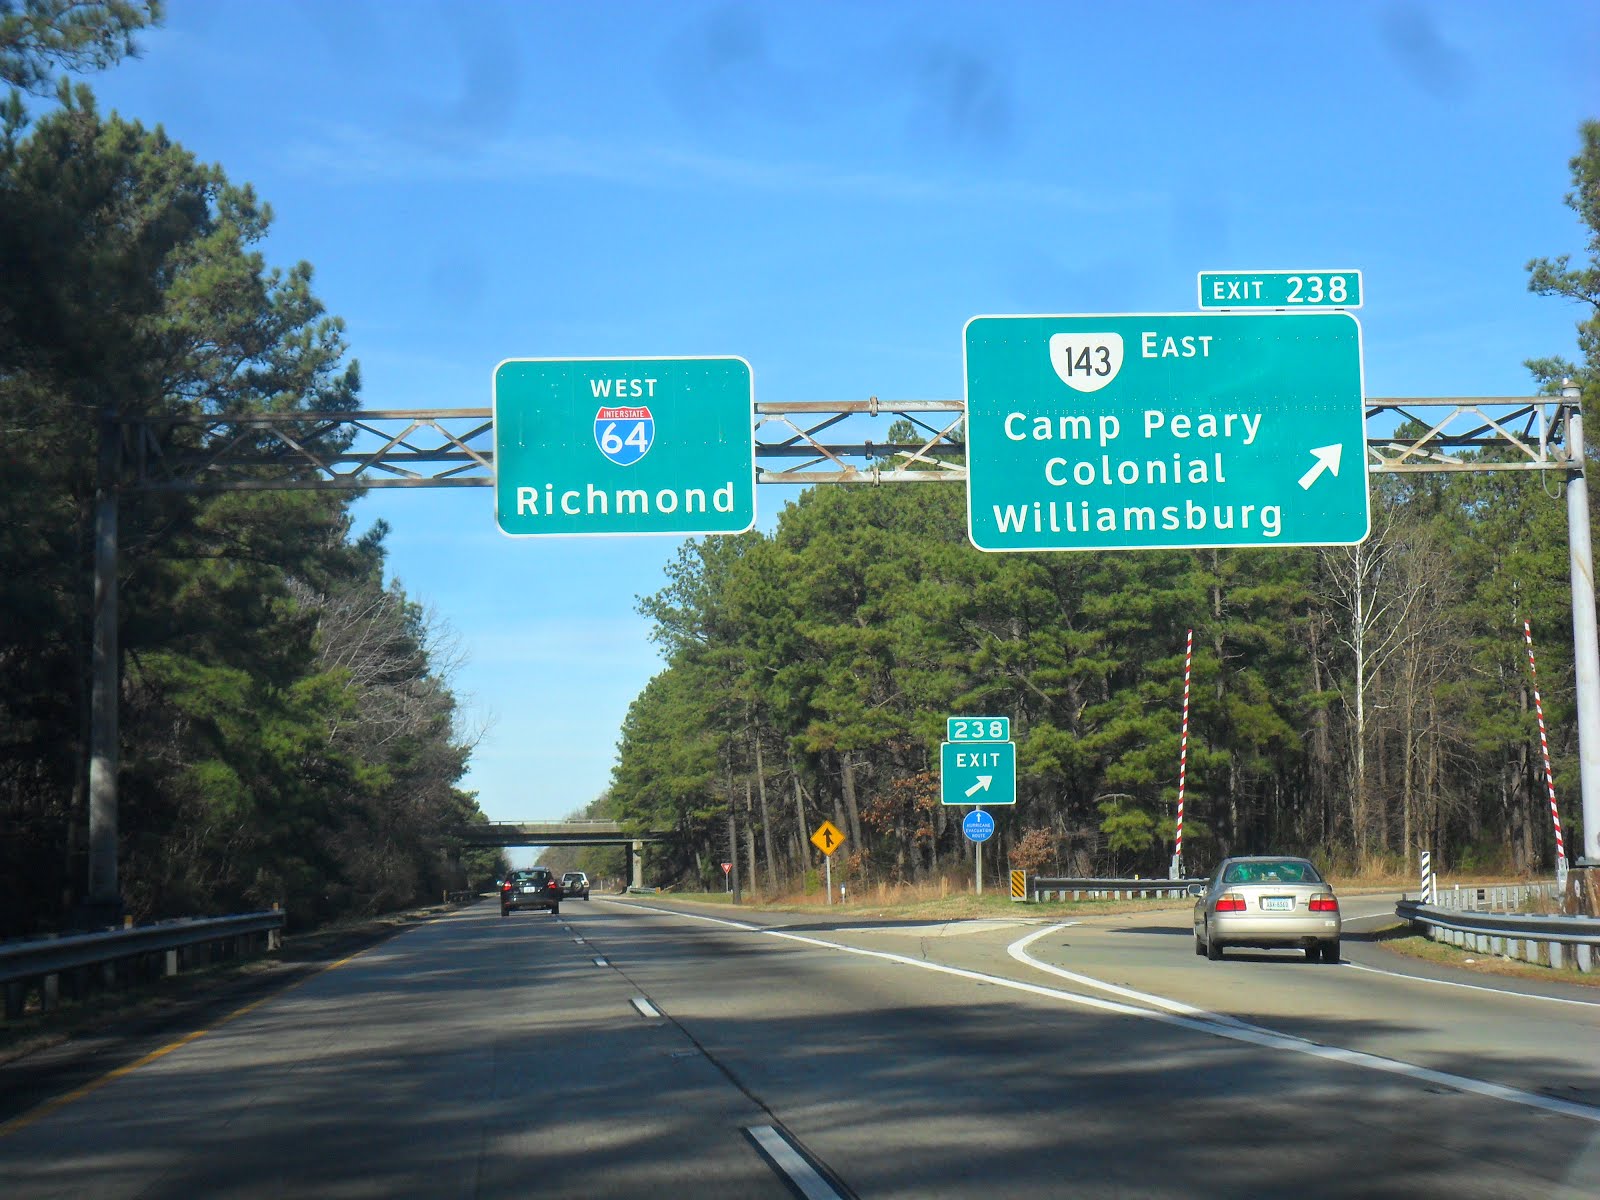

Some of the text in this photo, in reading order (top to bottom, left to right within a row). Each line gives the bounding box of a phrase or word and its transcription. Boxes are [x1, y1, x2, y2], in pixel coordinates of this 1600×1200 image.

[1213, 276, 1348, 303] EXIT 238
[1141, 331, 1213, 358] EAST
[1065, 345, 1112, 377] 143
[590, 378, 657, 397] WEST
[603, 409, 644, 418] INTERSTATE
[1004, 409, 1263, 447] Camp Peary
[601, 421, 648, 454] 64
[1045, 452, 1226, 486] Colonial
[516, 481, 734, 515] Richmond
[993, 500, 1283, 537] Williamsburg
[954, 720, 1003, 738] 238
[956, 753, 1000, 767] EXIT
